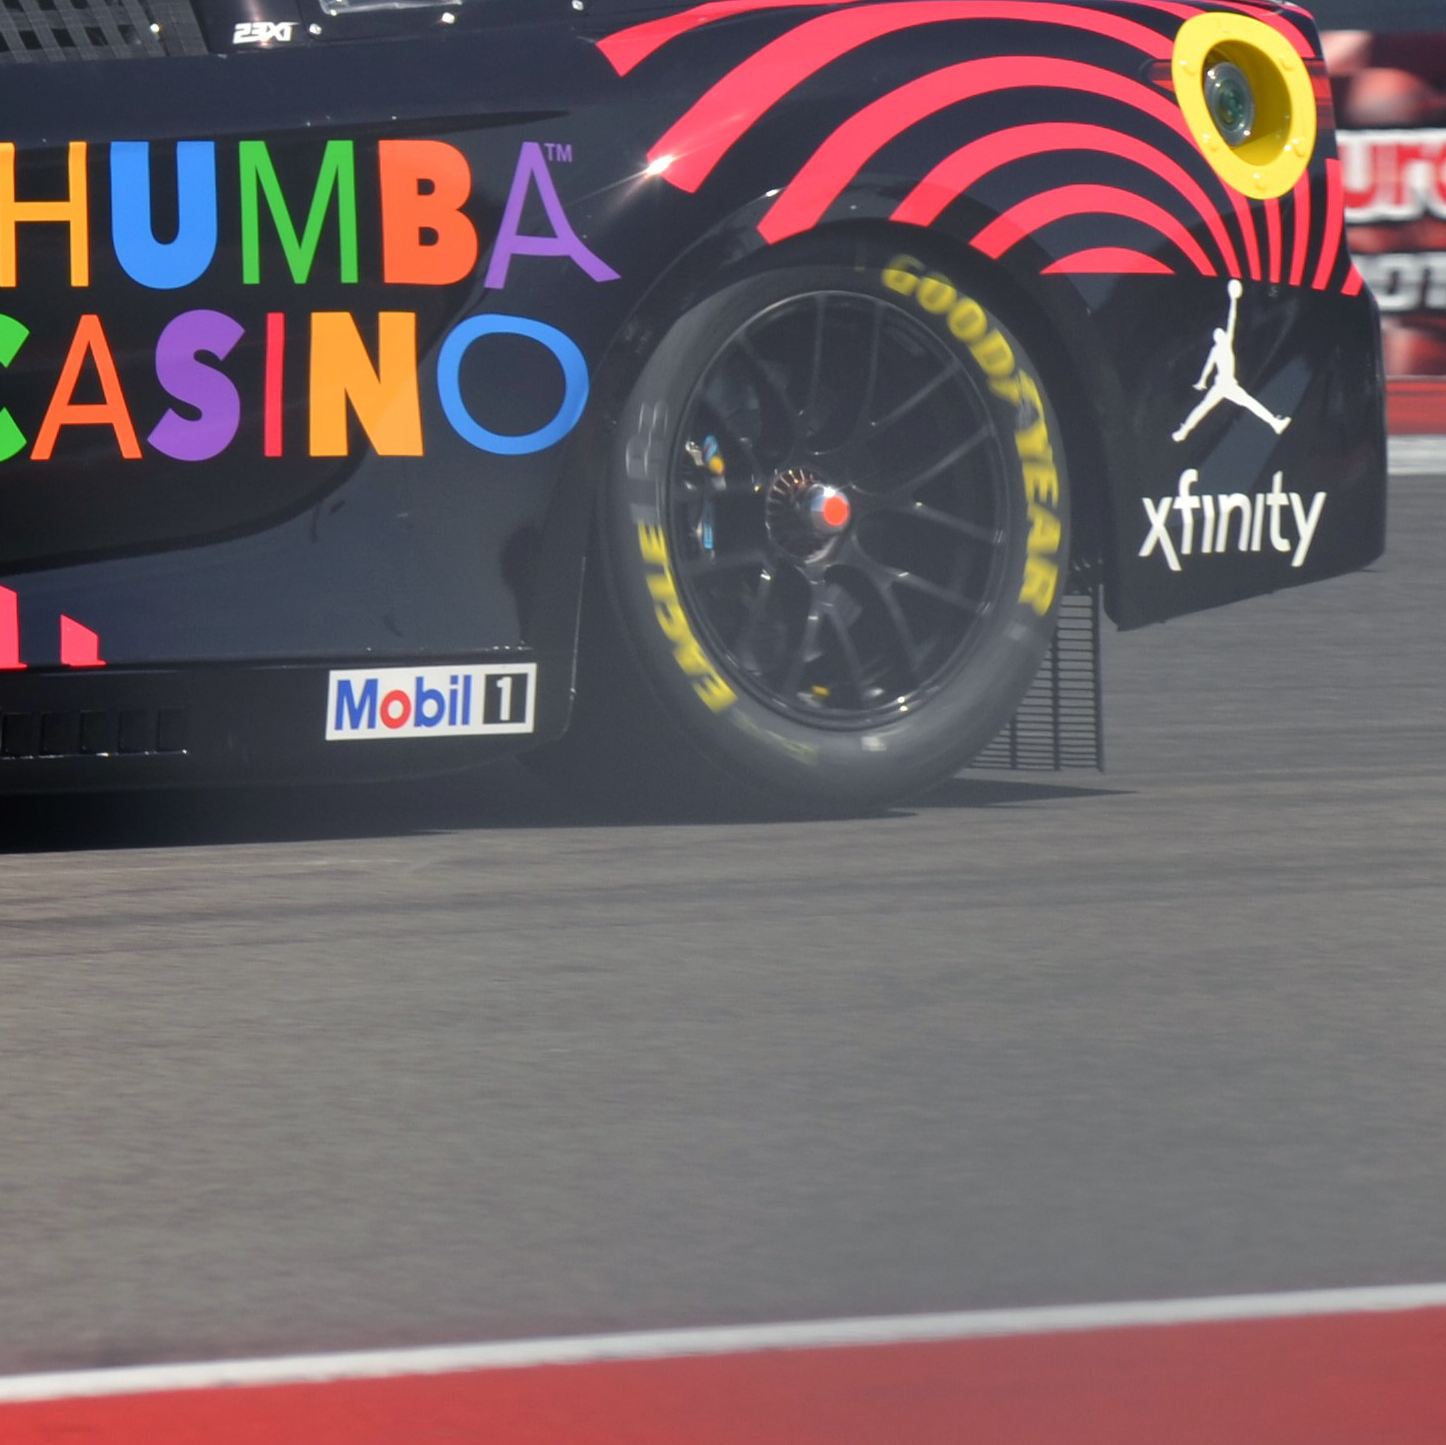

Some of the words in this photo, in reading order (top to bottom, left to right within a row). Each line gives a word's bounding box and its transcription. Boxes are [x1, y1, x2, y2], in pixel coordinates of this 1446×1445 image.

[1138, 468, 1327, 572] xfinity
[334, 674, 473, 731] Mobil
[496, 676, 513, 722] 1
